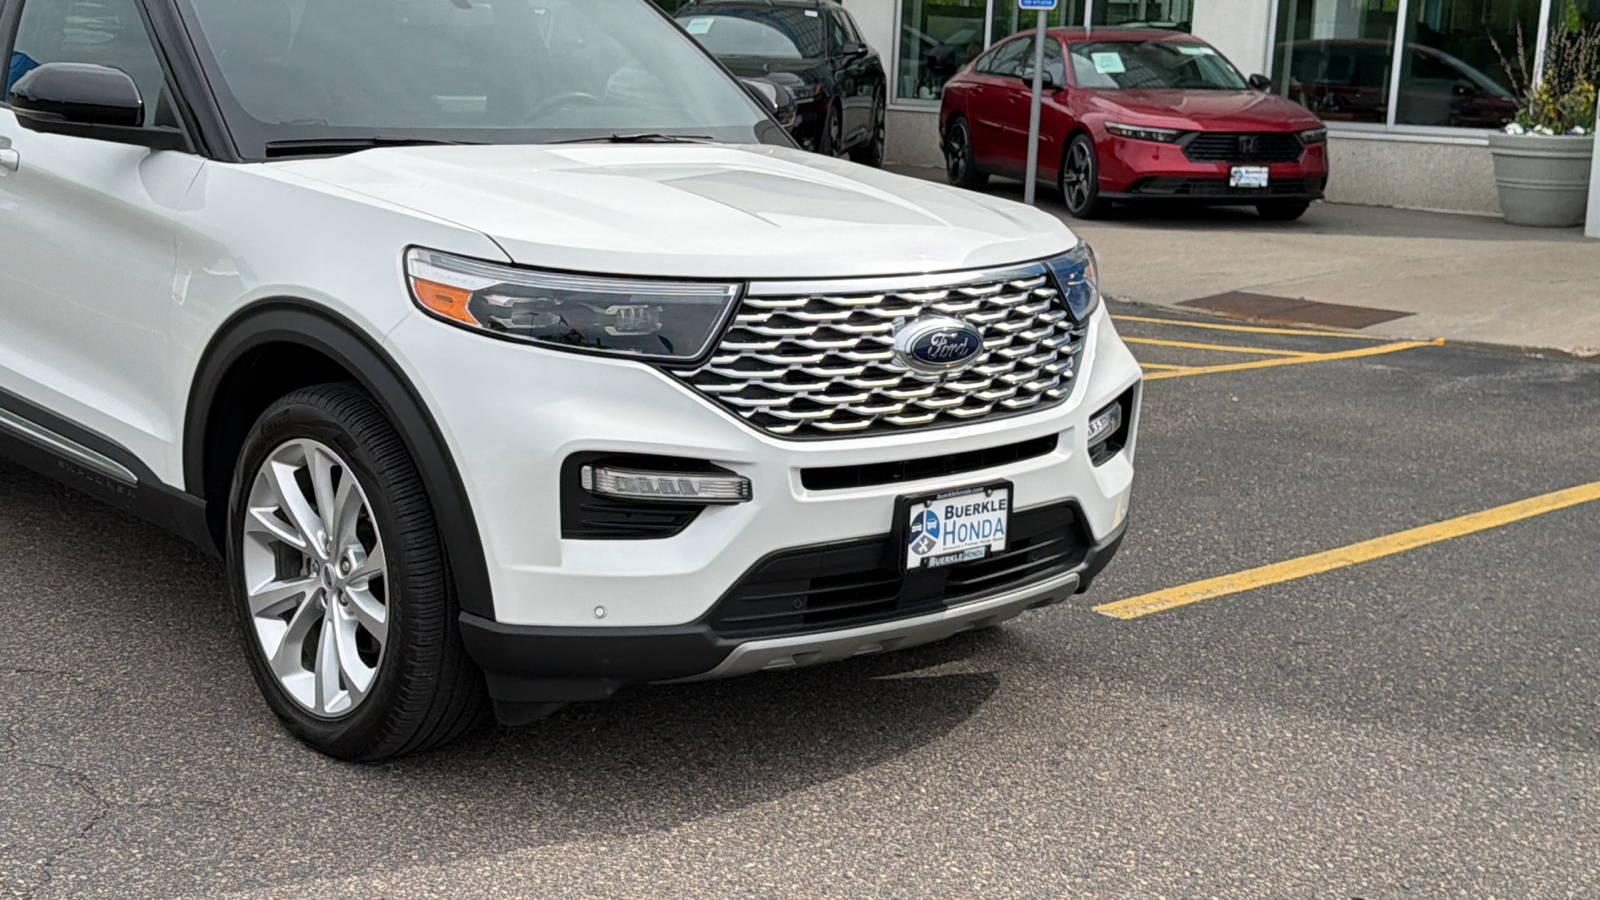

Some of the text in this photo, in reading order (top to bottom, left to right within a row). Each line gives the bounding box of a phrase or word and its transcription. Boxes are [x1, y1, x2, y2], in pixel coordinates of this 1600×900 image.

[927, 332, 969, 359] Ford
[944, 499, 1006, 521] BUERKLE
[943, 517, 1004, 546] HONDA
[928, 548, 983, 567] BUERKLE HONDA
